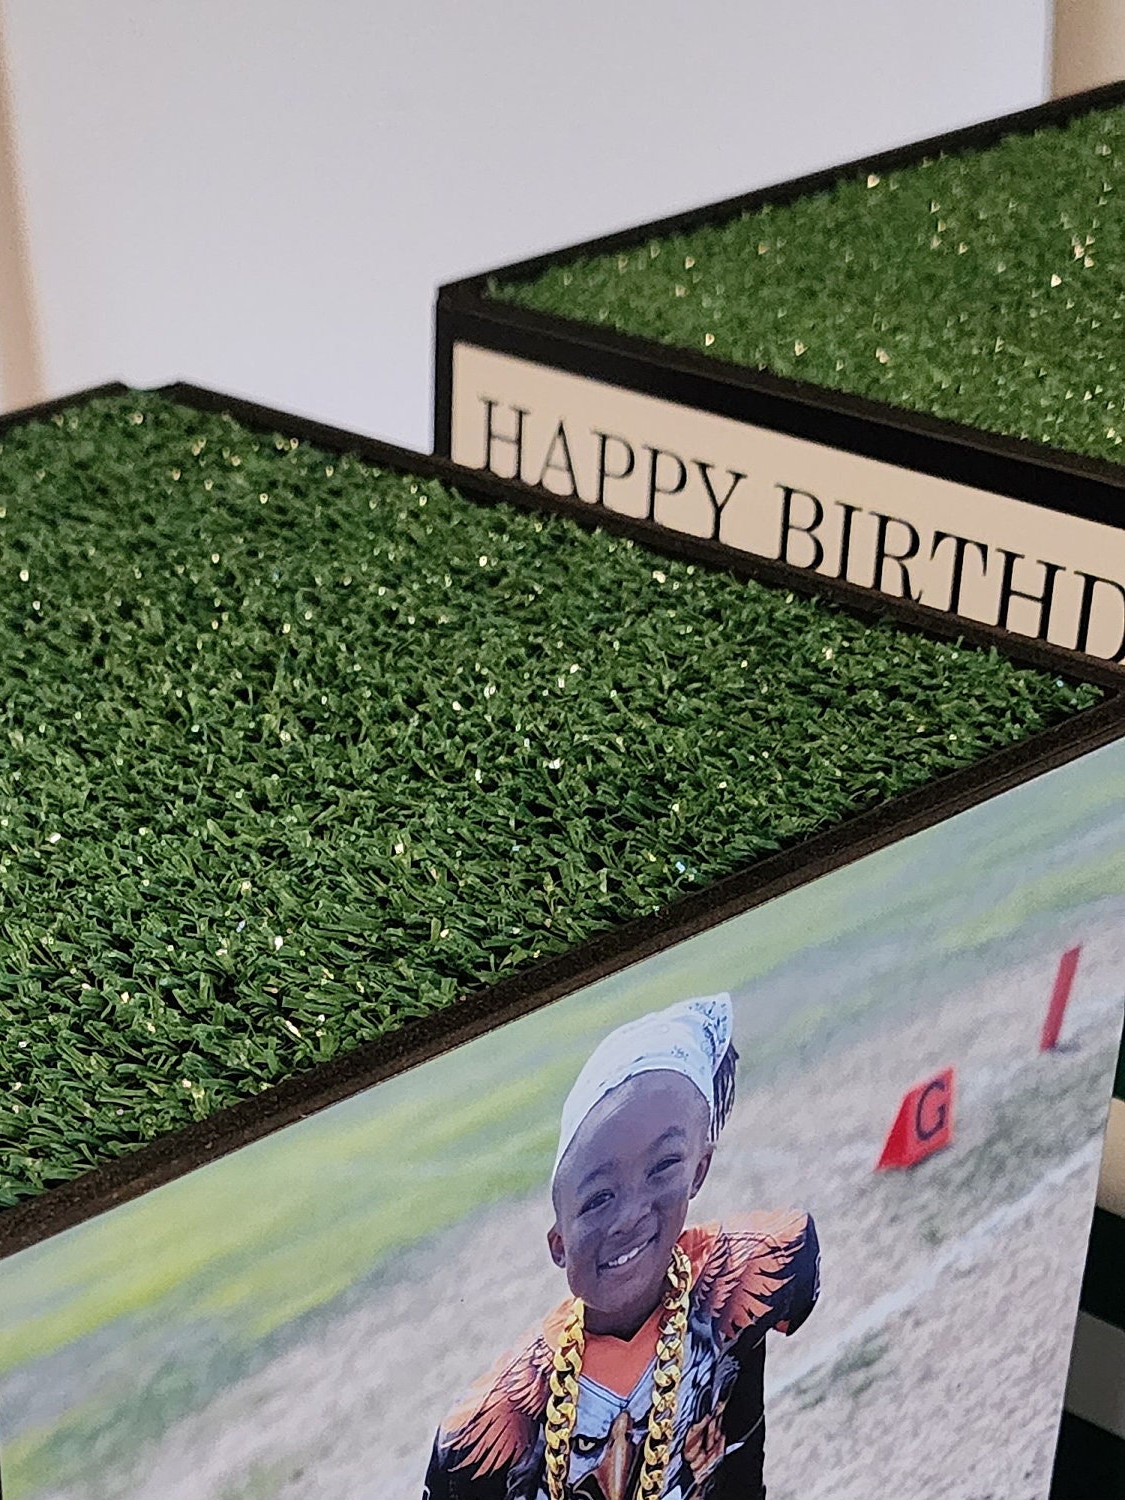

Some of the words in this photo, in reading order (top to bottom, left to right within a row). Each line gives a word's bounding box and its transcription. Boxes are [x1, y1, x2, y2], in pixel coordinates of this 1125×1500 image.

[478, 396, 747, 541] HAPPY
[774, 483, 1125, 664] BIRTHD
[916, 1080, 945, 1140] G
